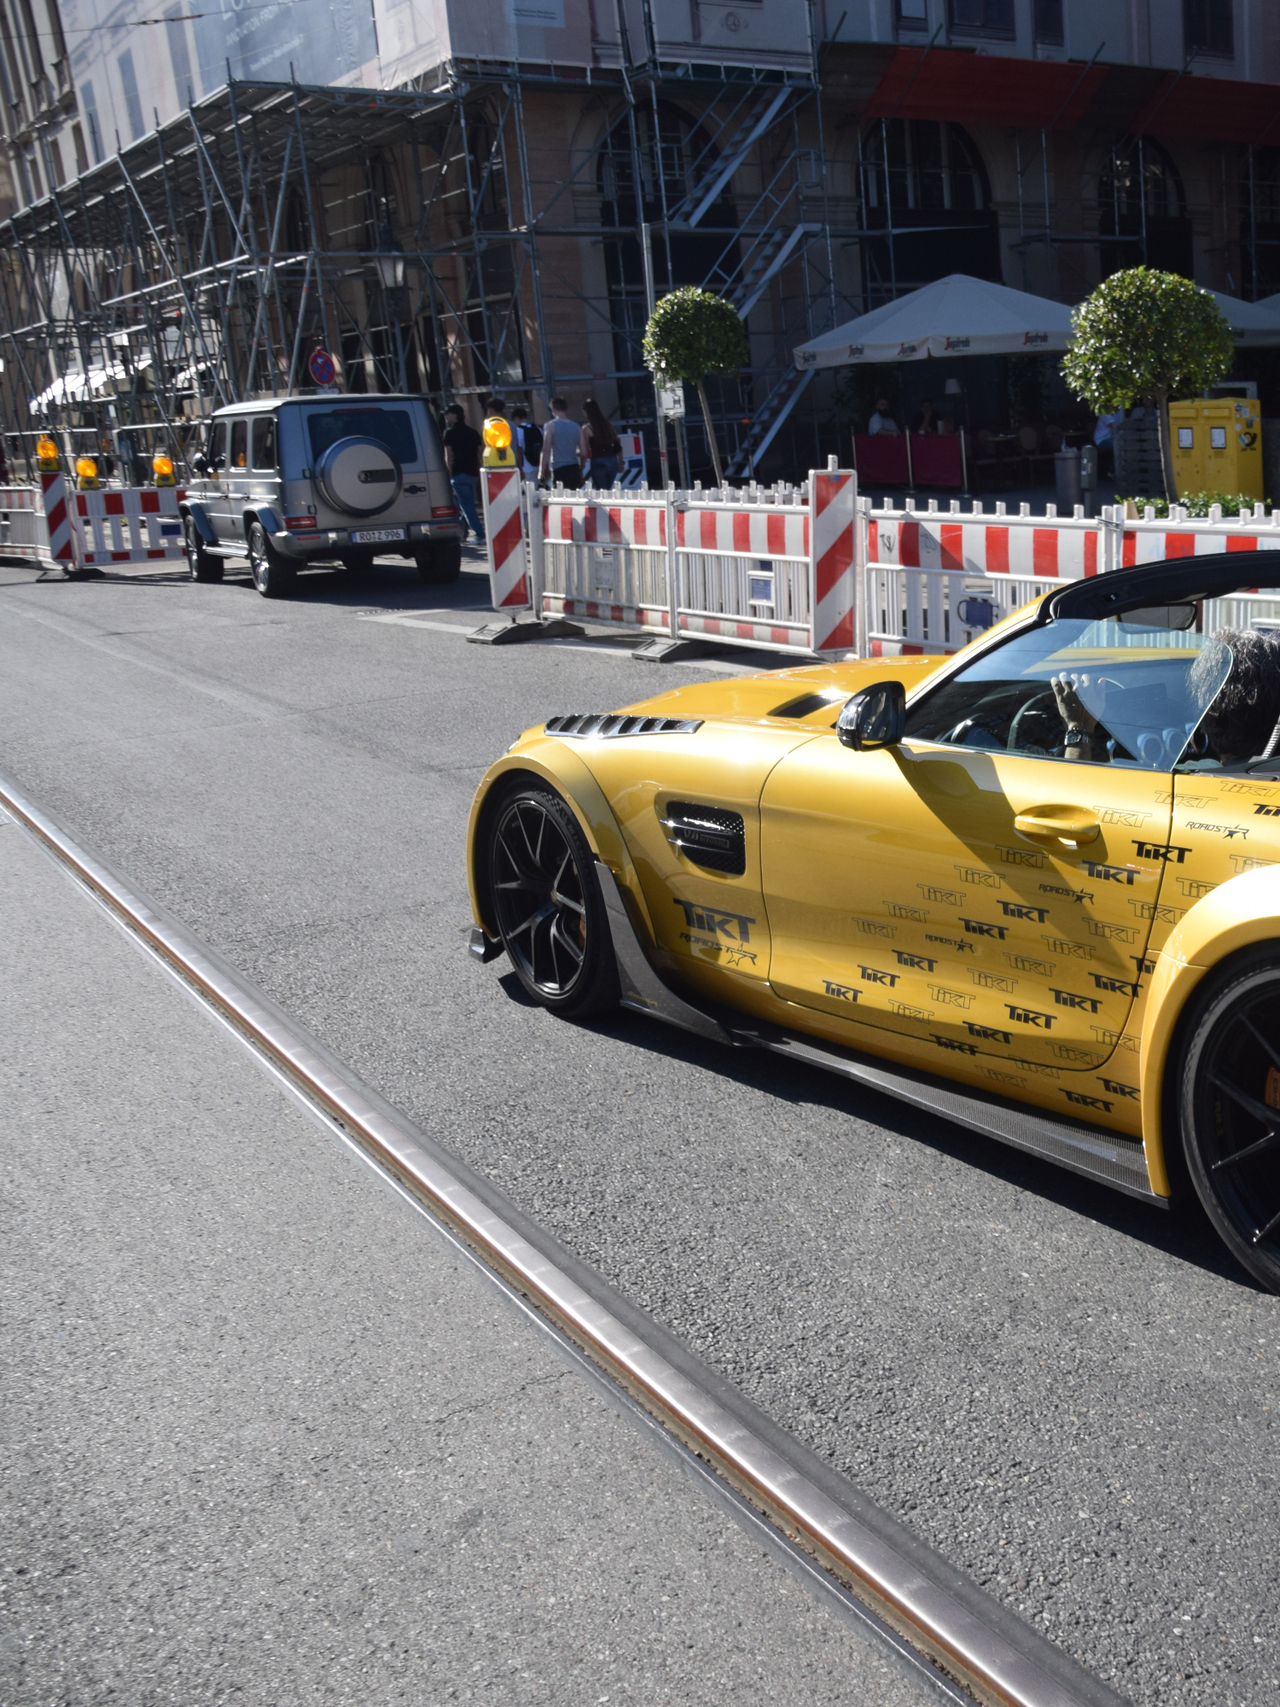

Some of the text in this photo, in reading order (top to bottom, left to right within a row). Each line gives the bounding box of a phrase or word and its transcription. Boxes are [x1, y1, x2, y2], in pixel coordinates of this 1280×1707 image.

[360, 533, 371, 542] RO
[385, 531, 401, 539] 996
[673, 898, 756, 943] TiKT
